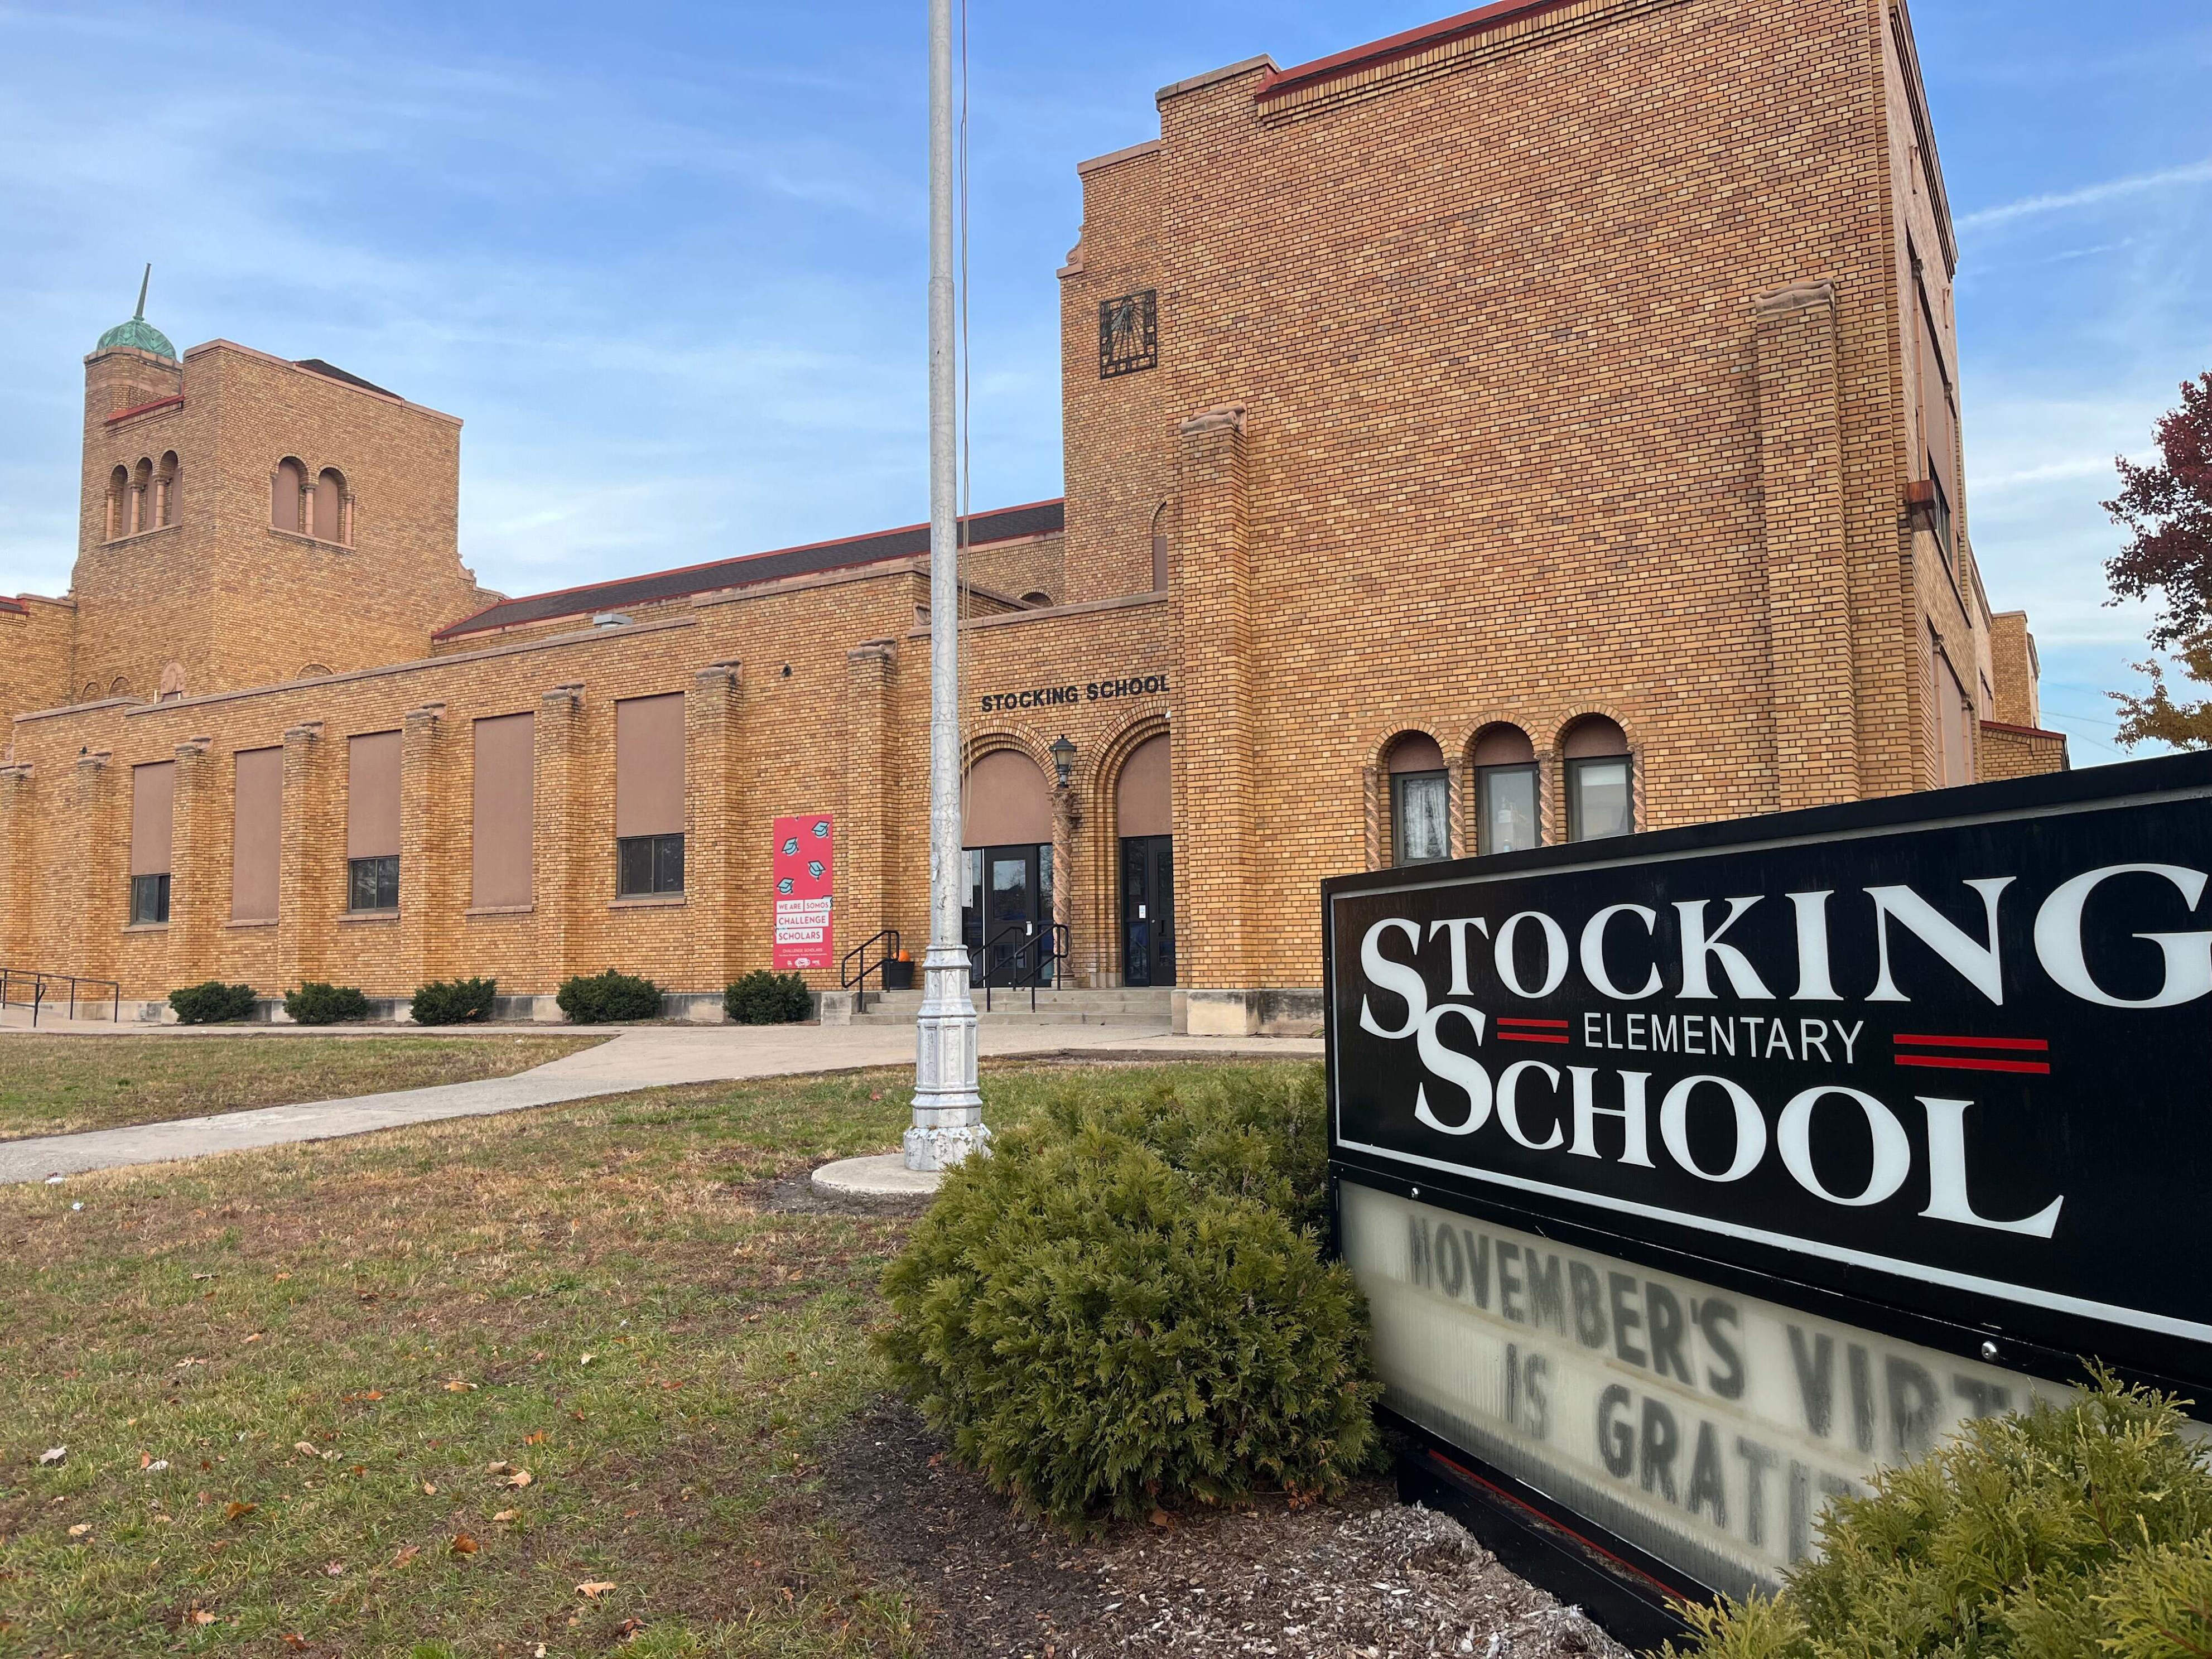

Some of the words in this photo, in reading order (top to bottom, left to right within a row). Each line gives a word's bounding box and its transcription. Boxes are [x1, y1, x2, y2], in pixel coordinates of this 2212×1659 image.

[982, 686, 1078, 712] STOCKING
[1087, 676, 1170, 701] SCHOOL
[779, 915, 826, 925] CHALLENGE
[779, 932, 821, 941] SCHOLARS
[1359, 863, 2212, 1040] STOCKING
[1584, 1012, 1864, 1064] ELEMENTARY
[1414, 1003, 2064, 1239] SCHOOL
[1408, 1215, 1747, 1401] NOVEMBER'S
[1506, 1342, 1548, 1441] IS
